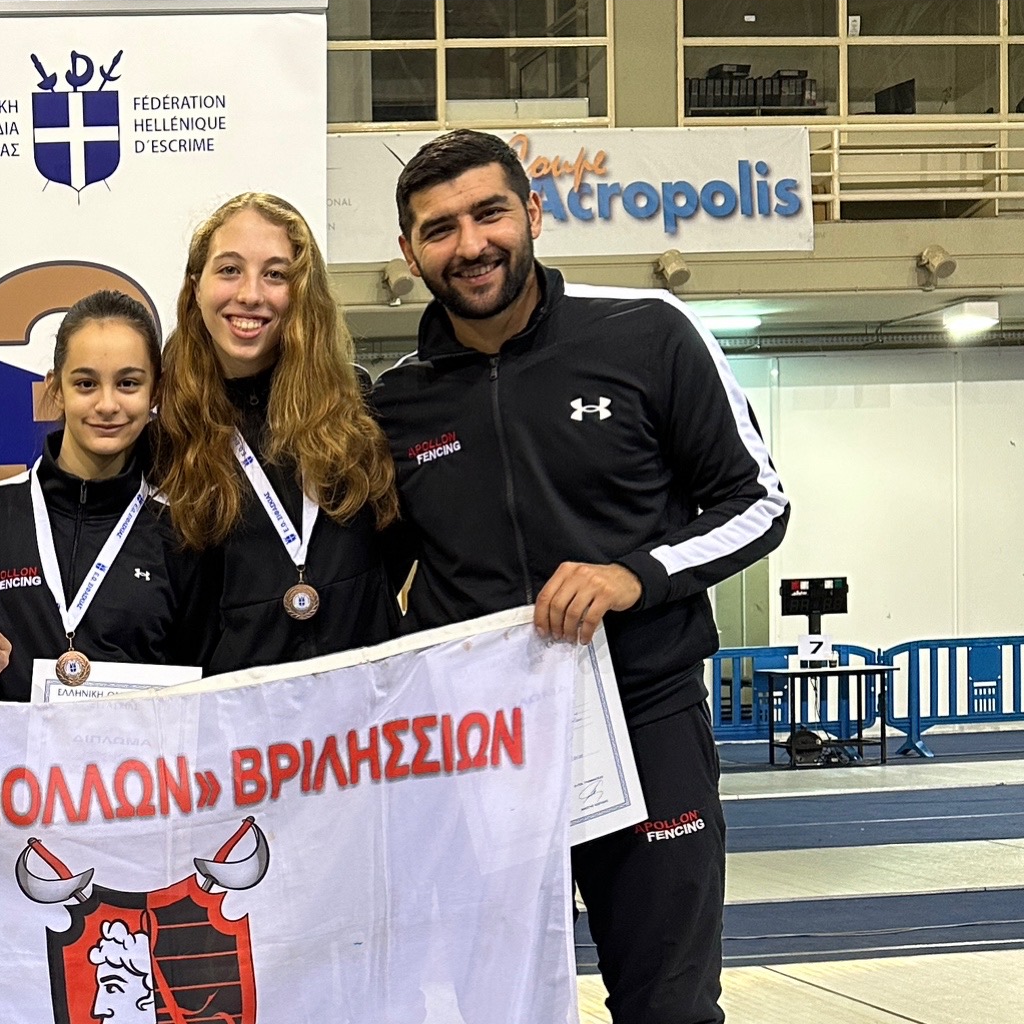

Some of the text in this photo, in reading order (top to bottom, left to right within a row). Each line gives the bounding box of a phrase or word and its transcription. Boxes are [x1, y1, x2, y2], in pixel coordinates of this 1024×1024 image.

[133, 94, 226, 111] FÉDÉRATION
[133, 116, 226, 132] HELLÉNIQUE
[531, 159, 802, 234] Acropolis
[407, 431, 457, 458] APOLLON
[416, 440, 461, 465] FENCING
[809, 641, 824, 655] 7
[57, 688, 104, 698] ΕΛΛΗΝΙΚΗ
[232, 707, 525, 807] ΒΡΙΛΗΣΣΙΩΝ
[634, 809, 699, 835] APOLLON
[646, 818, 705, 843] FENCING
